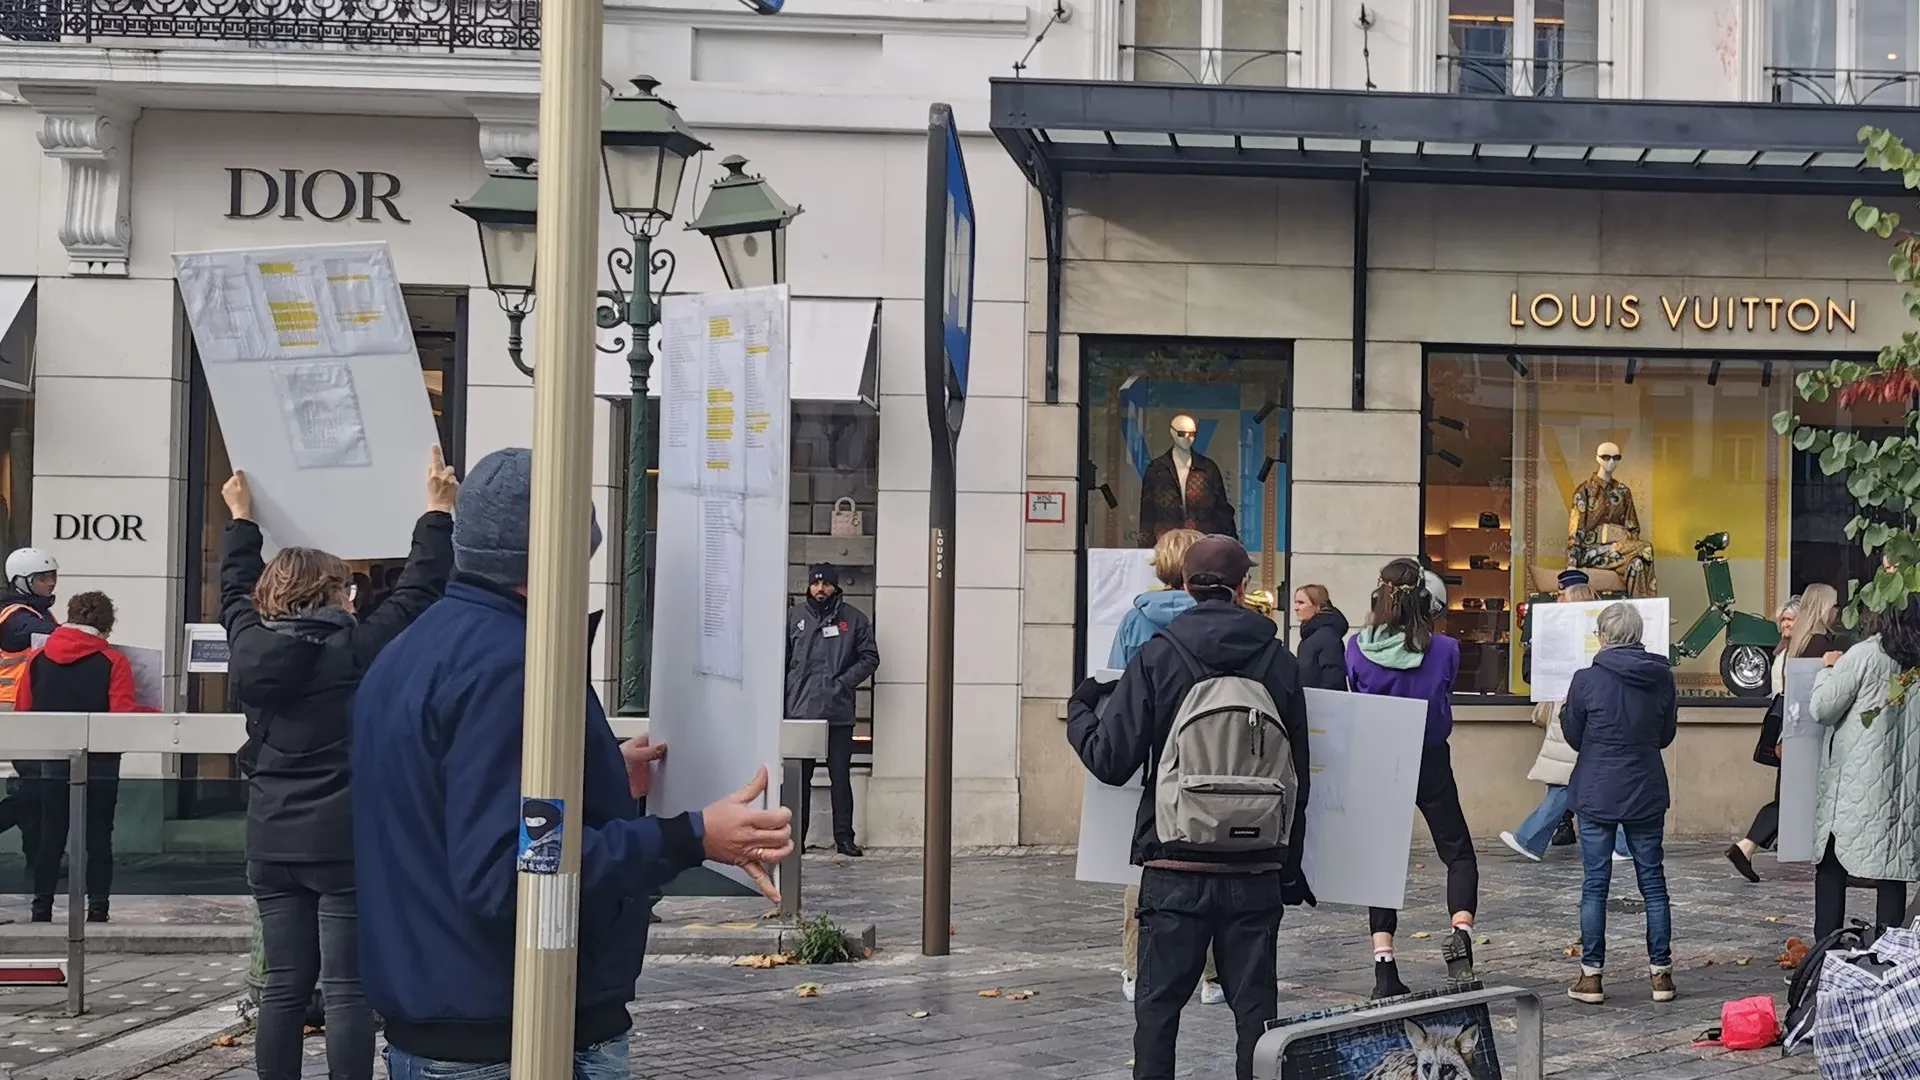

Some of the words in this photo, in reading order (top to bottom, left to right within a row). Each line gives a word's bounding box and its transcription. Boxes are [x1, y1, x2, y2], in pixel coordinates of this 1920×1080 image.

[223, 167, 411, 223] DIOR
[1510, 293, 1641, 329] LOUIS
[1660, 295, 1857, 332] VUITTON
[53, 513, 147, 542] DIOR
[1541, 537, 1567, 547] LOUI
